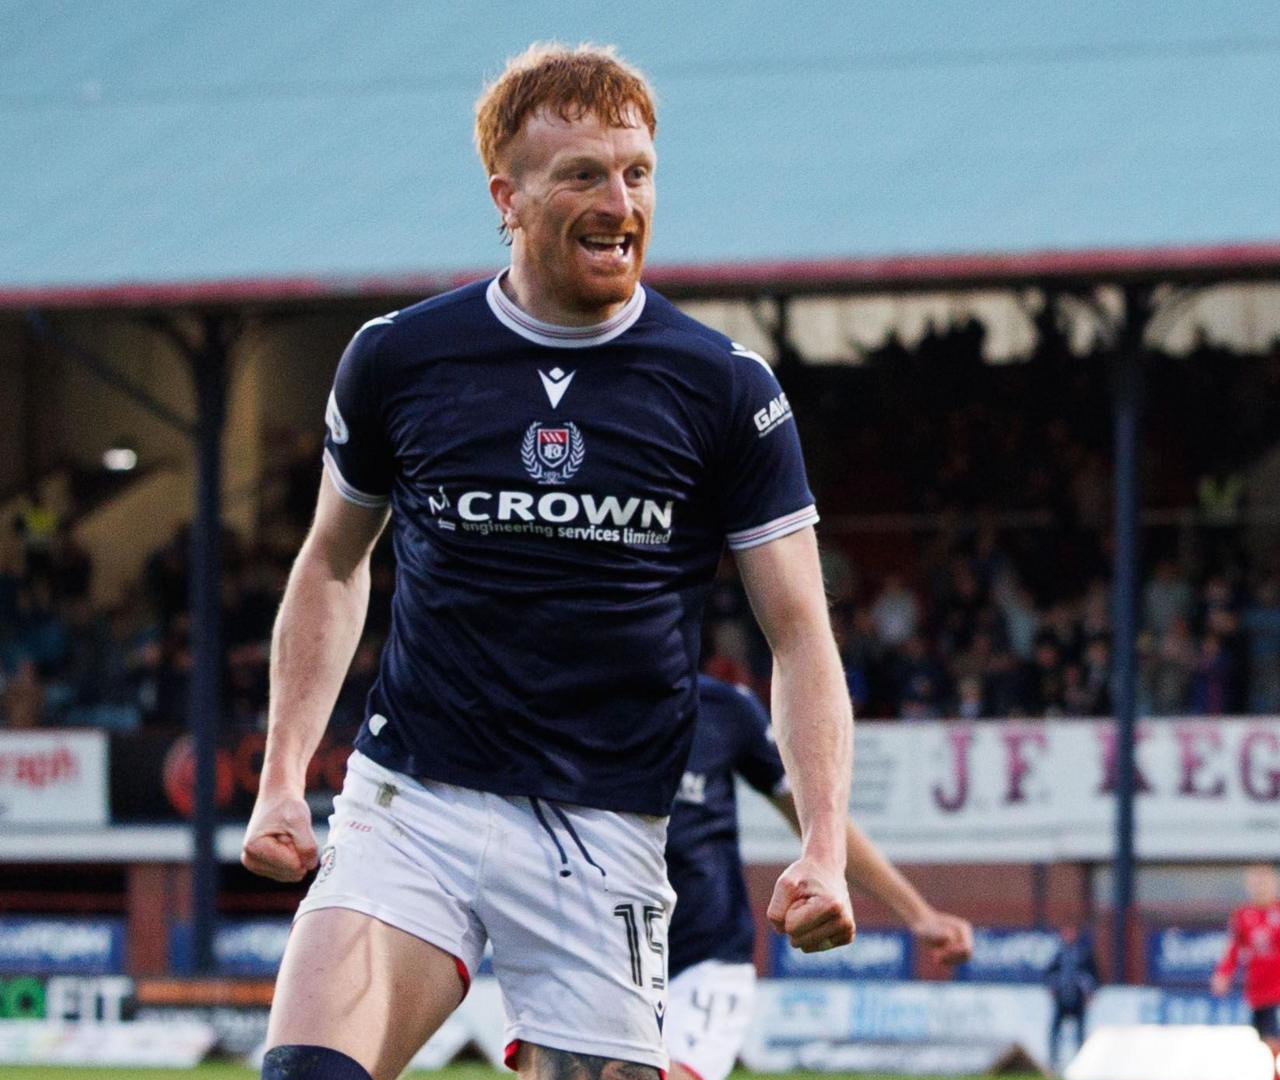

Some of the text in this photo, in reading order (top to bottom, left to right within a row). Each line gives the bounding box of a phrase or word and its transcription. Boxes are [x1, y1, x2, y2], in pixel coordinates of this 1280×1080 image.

[458, 491, 674, 528] CROWN
[462, 520, 672, 545] engineering services limited
